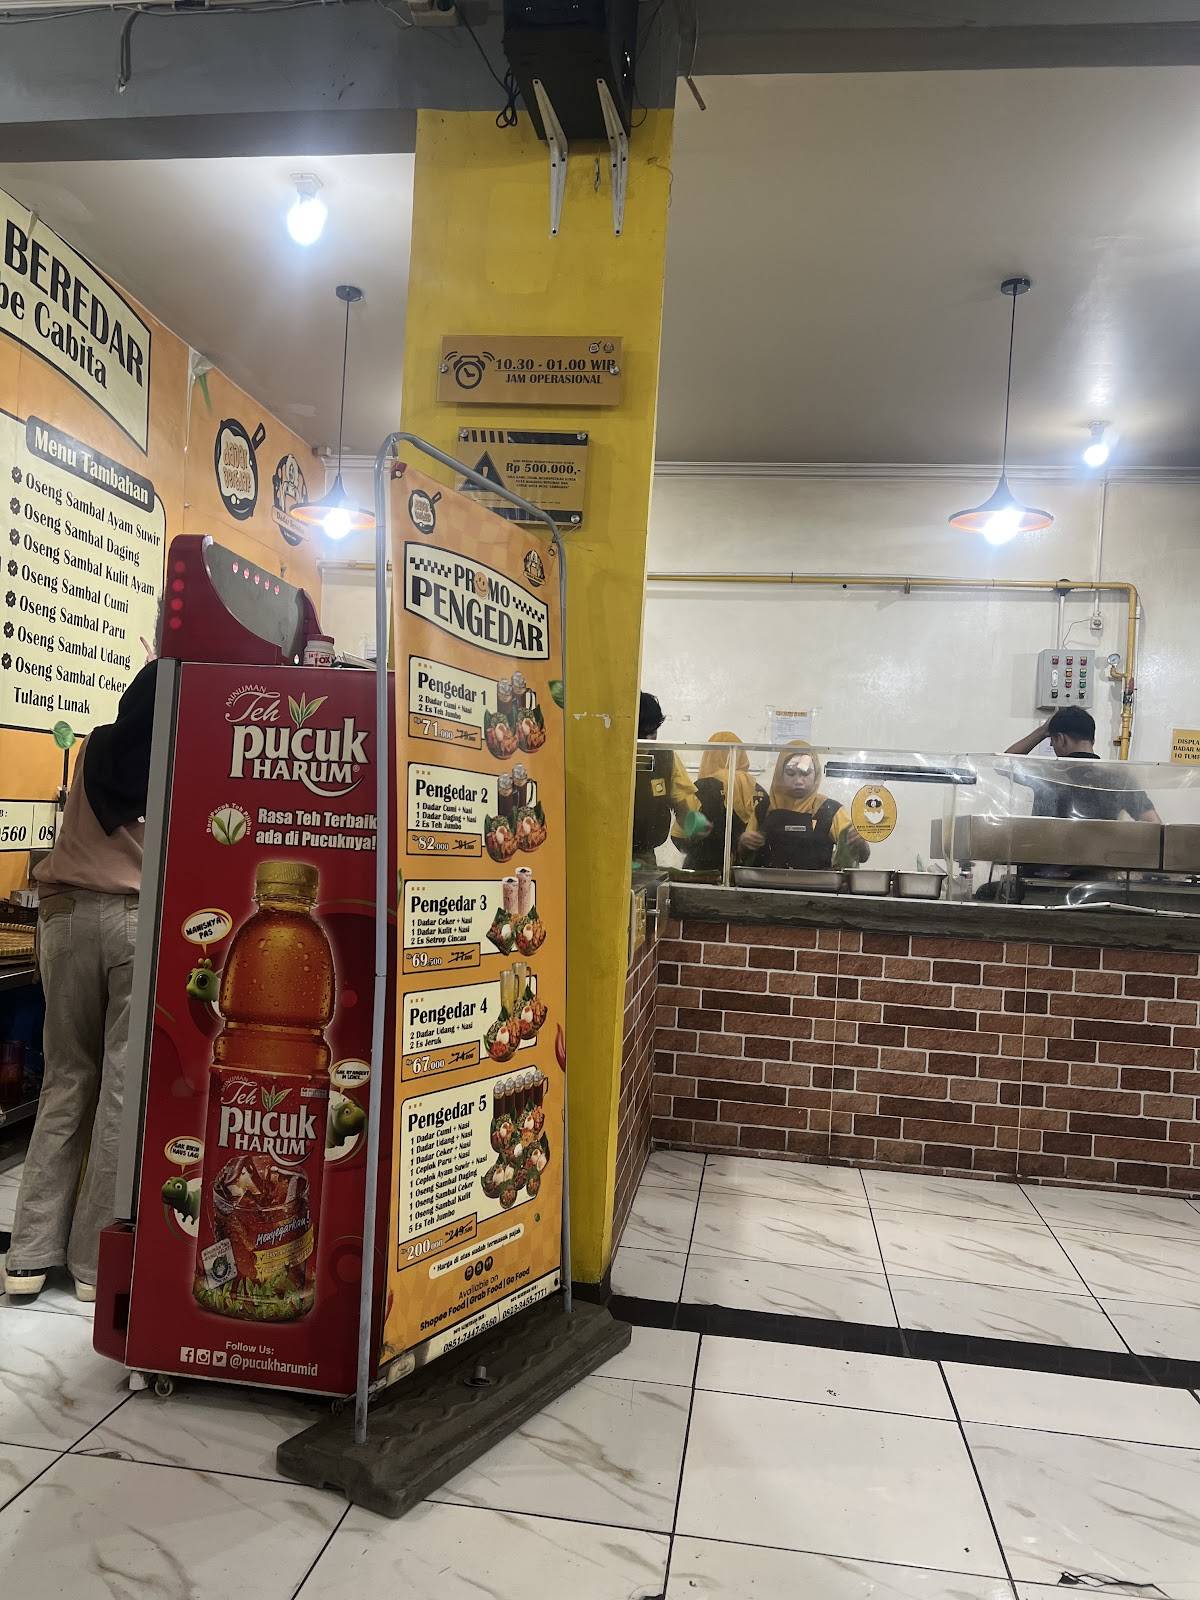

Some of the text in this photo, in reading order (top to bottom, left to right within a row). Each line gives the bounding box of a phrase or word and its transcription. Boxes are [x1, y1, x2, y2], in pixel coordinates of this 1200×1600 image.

[4, 219, 144, 387] BEREDAR
[34, 302, 107, 390] Cabita
[495, 359, 535, 371] 10.30
[546, 359, 586, 371] 01.00
[506, 374, 603, 385] JAM OPERASIONAL
[34, 426, 149, 506] Menu Tambahan
[506, 463, 581, 476] Rp 500.000,-
[26, 472, 161, 548] Oseng Sambal Ayam Suwir
[24, 503, 140, 567] Oseng Sambal Daging
[23, 535, 155, 597] Oseng Sambal Kulit Ayam
[22, 564, 130, 614] Oseng Sambal Cumi
[19, 595, 126, 641] Oseng Sambal Paru
[411, 575, 544, 652] PENGEDAR
[17, 626, 132, 672] Oseng Sambal Udang
[15, 656, 128, 695] Oseng Sambal Ceker
[13, 686, 91, 716] Tulang Lunak
[224, 684, 267, 708] MINUMAN
[418, 671, 486, 706] Pengedar 1
[425, 695, 442, 706] Dadar
[224, 691, 281, 723] Teh
[425, 704, 462, 720] Es Teh Jumbo
[228, 717, 369, 779] pucuk
[252, 758, 360, 792] HARUM
[416, 779, 488, 804] Pengedar 2
[211, 803, 231, 817] Pucuk
[232, 803, 244, 813] Teh
[243, 810, 253, 836] Pilihan
[258, 808, 377, 831] Rasa Teh Terbaik
[422, 802, 457, 813] Dadar Cumi
[422, 812, 462, 823] Dadar Daging
[38, 825, 55, 841] 08
[431, 821, 442, 829] Teh
[444, 822, 462, 830] Jumbo
[255, 829, 377, 852] ada di Pucuknya!
[411, 895, 488, 916] Pengedar 3
[185, 917, 222, 940] MANISNYA PAS
[417, 918, 456, 927] Dadar Ceker
[417, 926, 452, 936] Dadar Kulit
[417, 934, 467, 945] Es Setrop Cincau
[410, 997, 488, 1026] Pengedar 4
[416, 1026, 456, 1039] Dadar Udang
[416, 1037, 442, 1049] Es Jeruk
[220, 1081, 258, 1106] Teh
[408, 1094, 487, 1133] Pengedar 5
[217, 1105, 317, 1148] pucuk
[416, 1121, 470, 1144] Dadar Cumi Nasi
[234, 1133, 308, 1162] HARUM
[416, 1129, 473, 1154] Dadar Udang Nasi
[415, 1157, 452, 1175] Ceplok Paru
[416, 1147, 453, 1164] Dadar Ceker
[415, 1167, 453, 1187] Ceplok Ayam
[415, 1169, 478, 1198] Oseng Sambal Daging
[415, 1181, 474, 1209] Oseng Sambal Ceker
[415, 1191, 472, 1220] Oseng Sambal Kulit
[256, 1210, 311, 1246] Menyegarkan!
[408, 1209, 456, 1234] 5 Es Teh Jumbo
[437, 1259, 453, 1272] Harga
[420, 1311, 448, 1332] Shopee
[448, 1299, 466, 1317] Food
[469, 1289, 487, 1305] Grab
[486, 1282, 503, 1298] Food
[506, 1276, 516, 1285] Go
[515, 1266, 530, 1282] Food
[458, 1274, 499, 1301] Available on
[225, 1341, 275, 1356] Follow Us:
[230, 1354, 319, 1377] @pucukharumid
